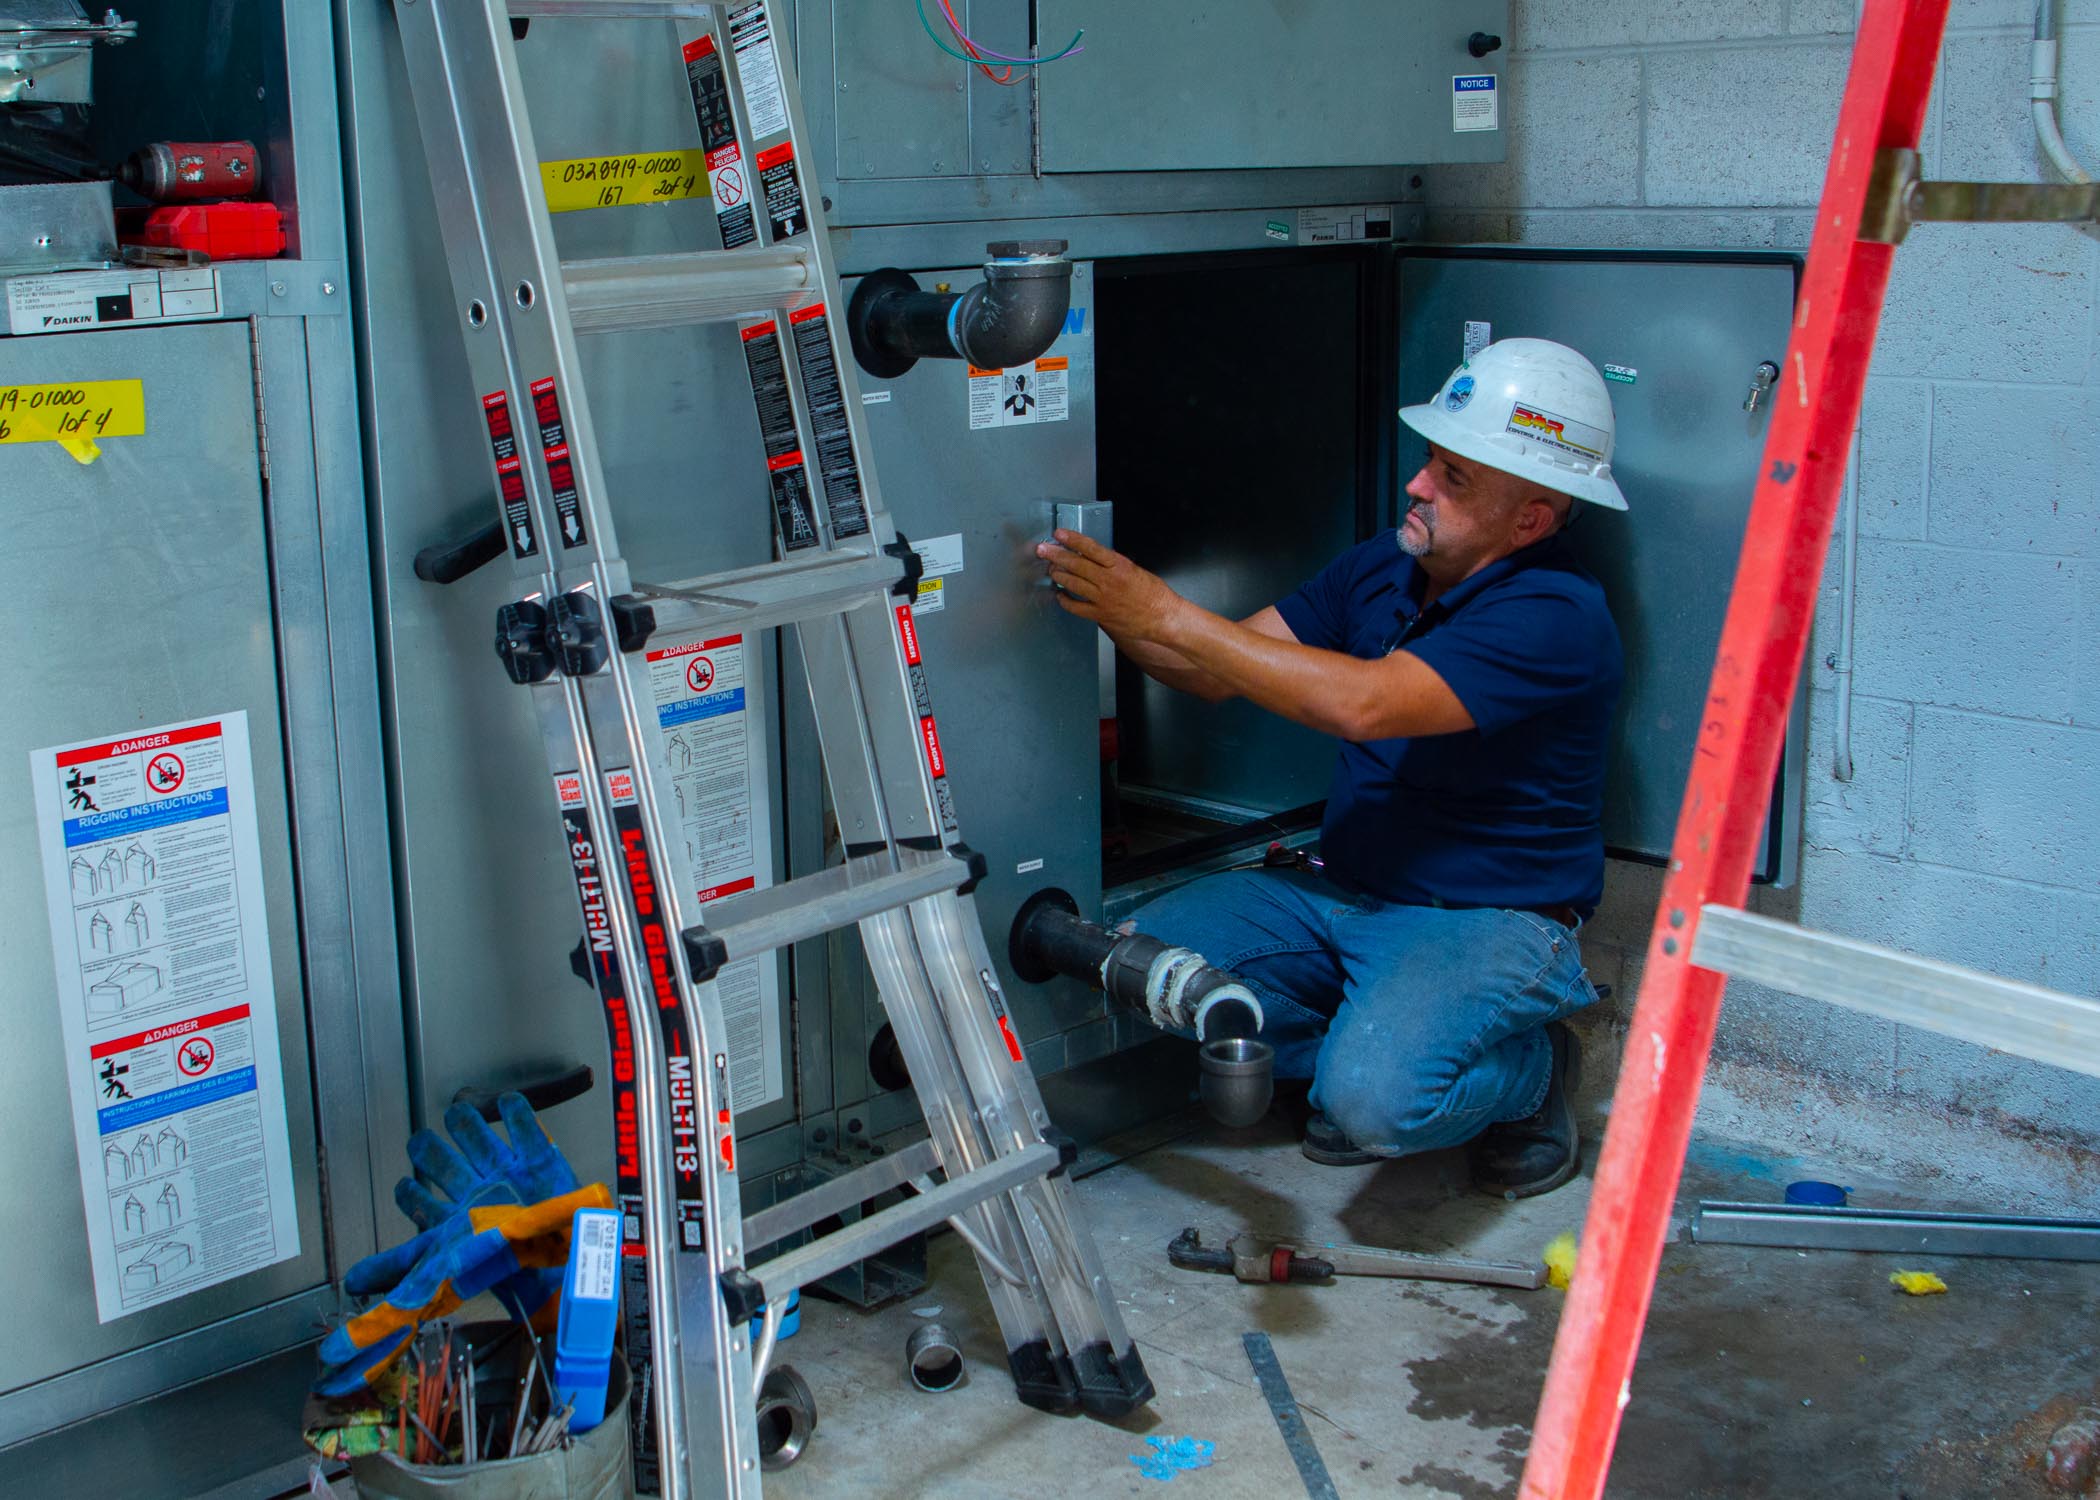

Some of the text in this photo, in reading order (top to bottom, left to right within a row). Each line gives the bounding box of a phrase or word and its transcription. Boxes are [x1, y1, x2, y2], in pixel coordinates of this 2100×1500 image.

[1460, 80, 1489, 88] NOTICE
[713, 145, 736, 160] DANGER
[714, 154, 739, 168] PELIGRO
[598, 186, 623, 206] 167
[54, 316, 92, 326] DAIKIN
[1508, 427, 1535, 440] CONTROL
[1542, 438, 1571, 452] ELECTRICAL
[670, 641, 705, 656] DANGER
[903, 620, 917, 659] DANGER
[675, 690, 735, 711] INSTRUCTIONS
[121, 735, 170, 753] DANGER
[927, 731, 941, 770] PELIGRO
[558, 778, 579, 790] Little
[609, 775, 631, 787] Little
[561, 790, 582, 801] Giant
[612, 787, 634, 798] Giant
[79, 810, 128, 828] RIGGING
[131, 791, 214, 816] INSTRUCTIONS
[573, 841, 613, 952] MULTI 13
[153, 1020, 199, 1041] DANGER
[103, 1096, 155, 1118] INSTRUCTIONS
[668, 1055, 698, 1173] MULTI 13
